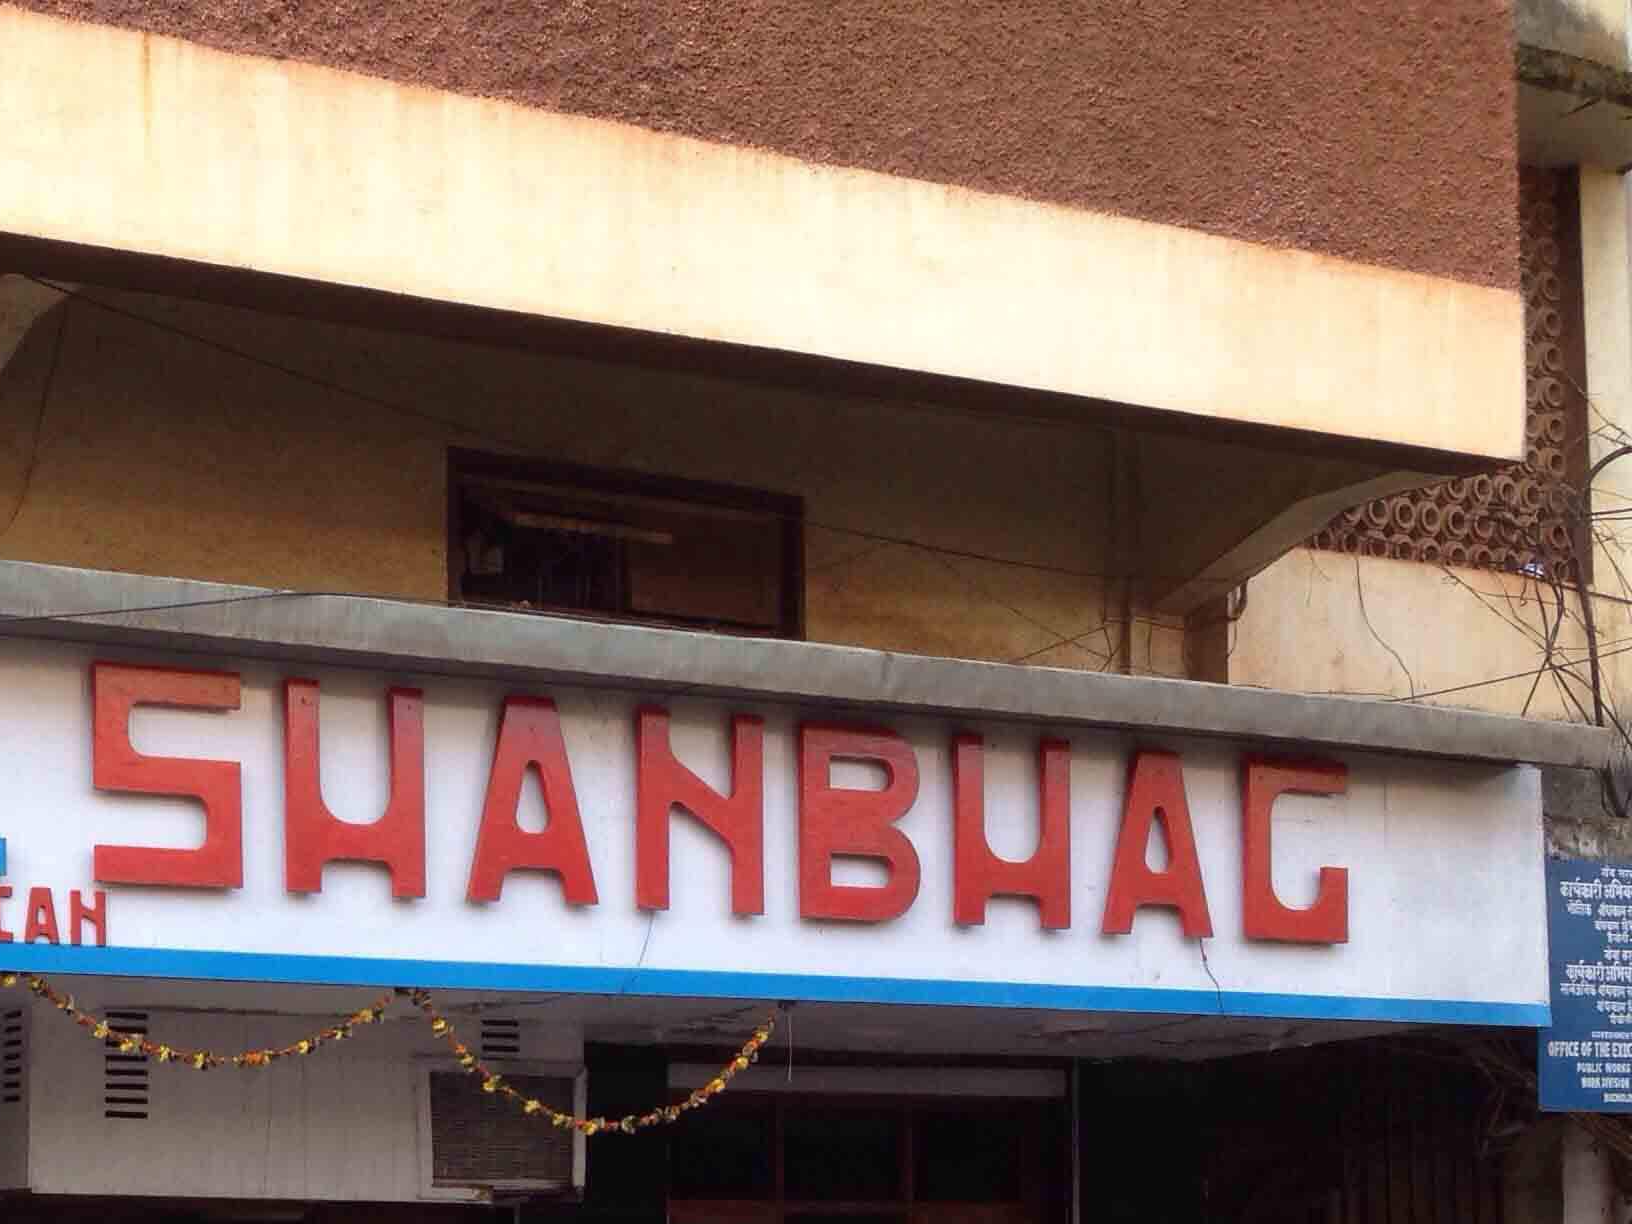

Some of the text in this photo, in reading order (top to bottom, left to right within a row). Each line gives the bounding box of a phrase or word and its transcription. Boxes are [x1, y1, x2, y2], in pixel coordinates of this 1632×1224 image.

[91, 661, 1349, 945] SHANBHAG
[1548, 1040, 1579, 1057] OFFICE
[1580, 1041, 1593, 1057] OF
[1594, 1042, 1610, 1058] THE
